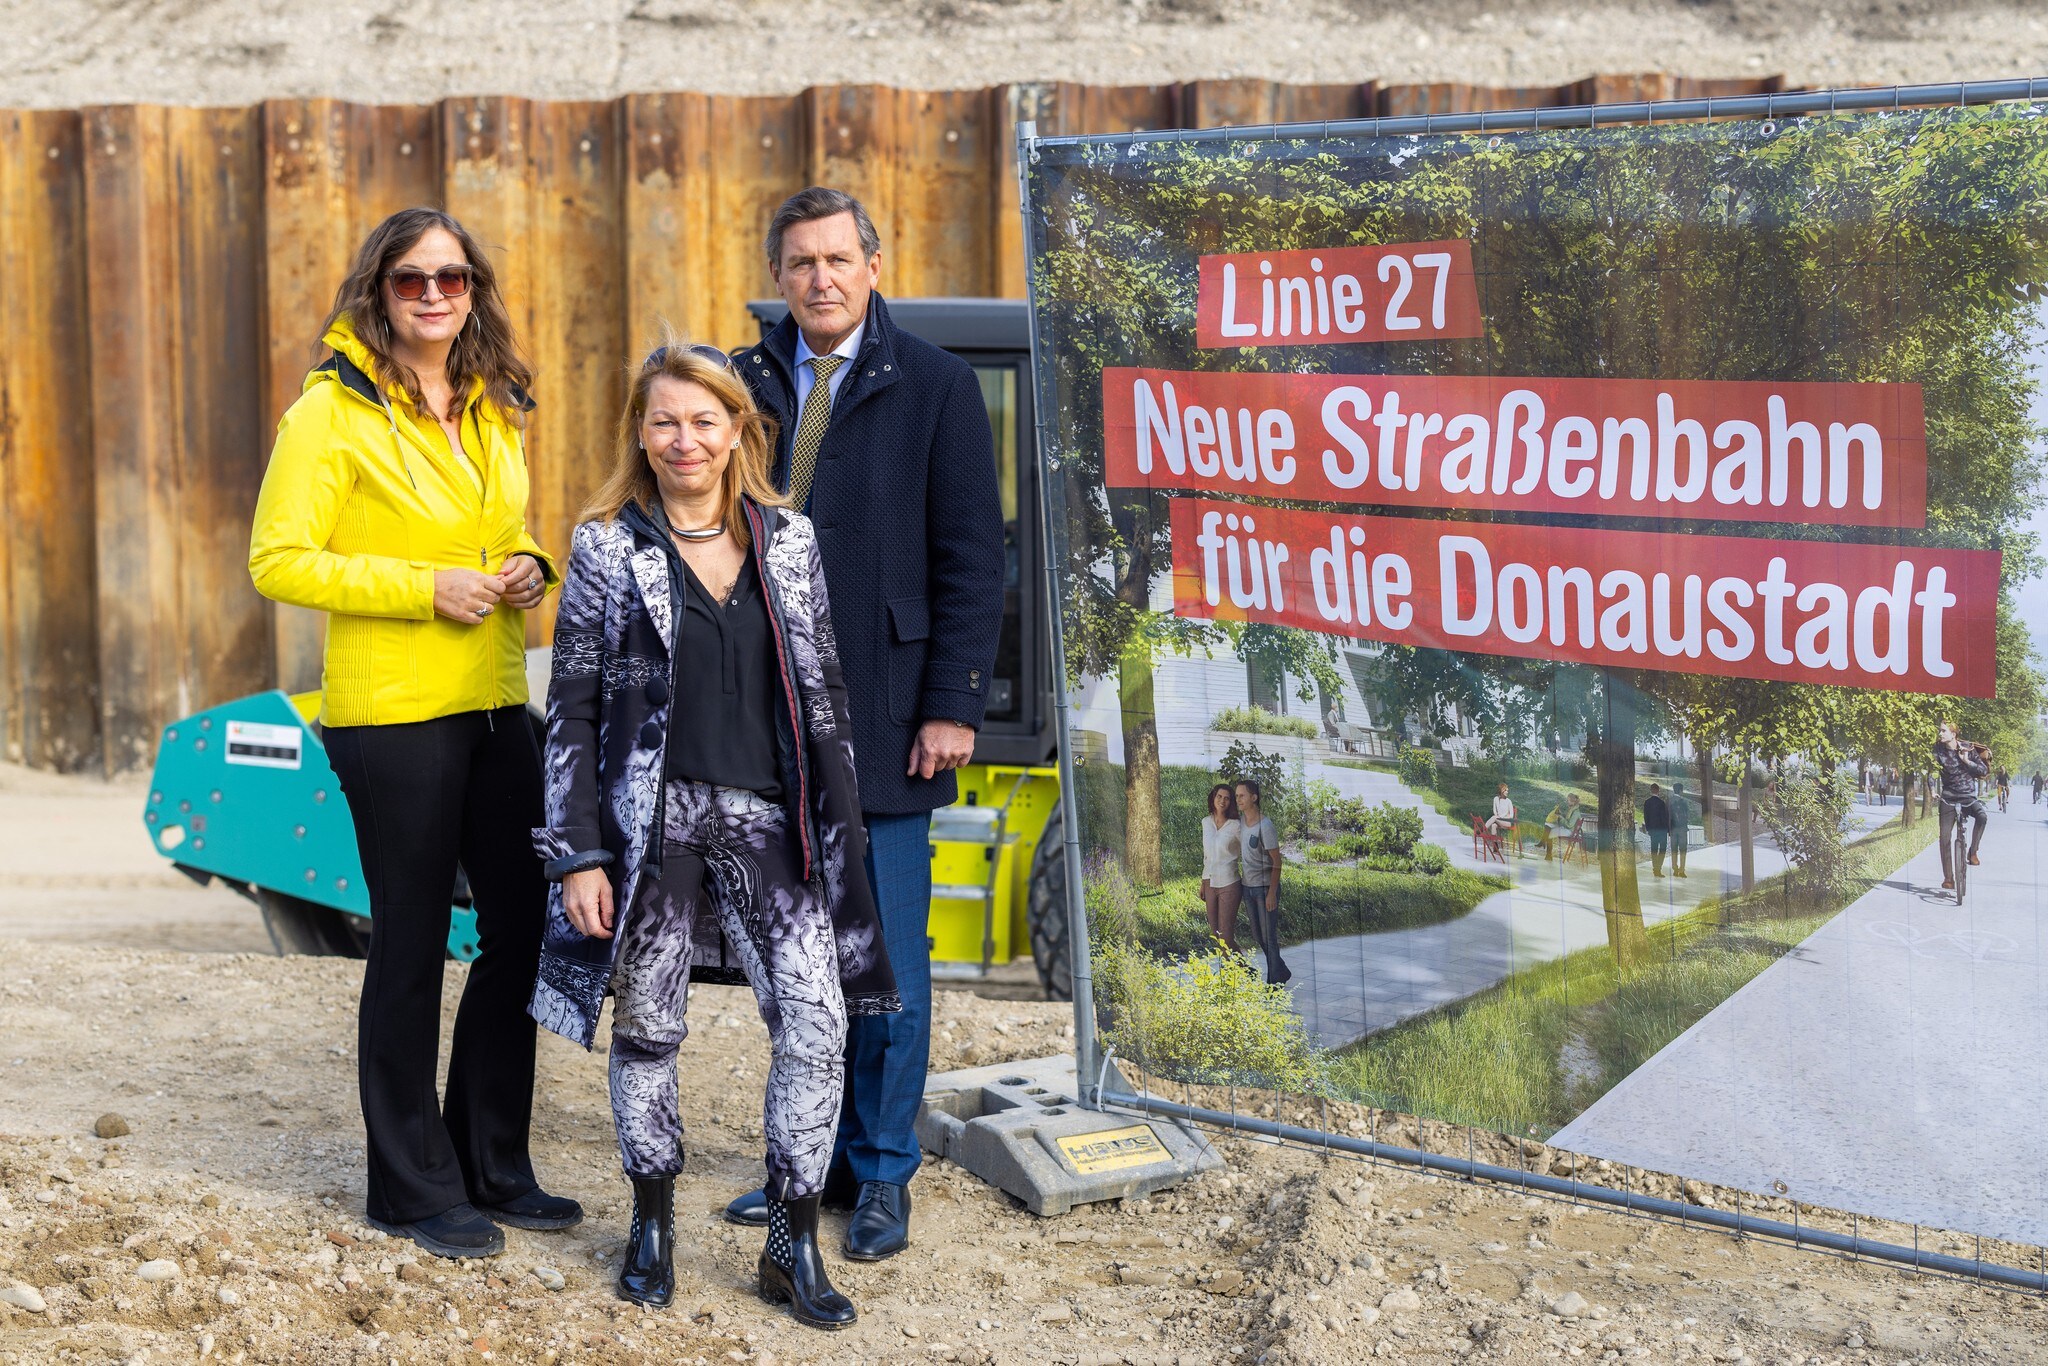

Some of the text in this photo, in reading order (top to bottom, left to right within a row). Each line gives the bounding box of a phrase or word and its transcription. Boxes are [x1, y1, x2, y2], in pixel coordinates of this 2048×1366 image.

[1219, 252, 1452, 338] Linie 27
[1133, 378, 1883, 511] Neue Straßenbahn
[1196, 510, 1957, 678] für die Donaustadt
